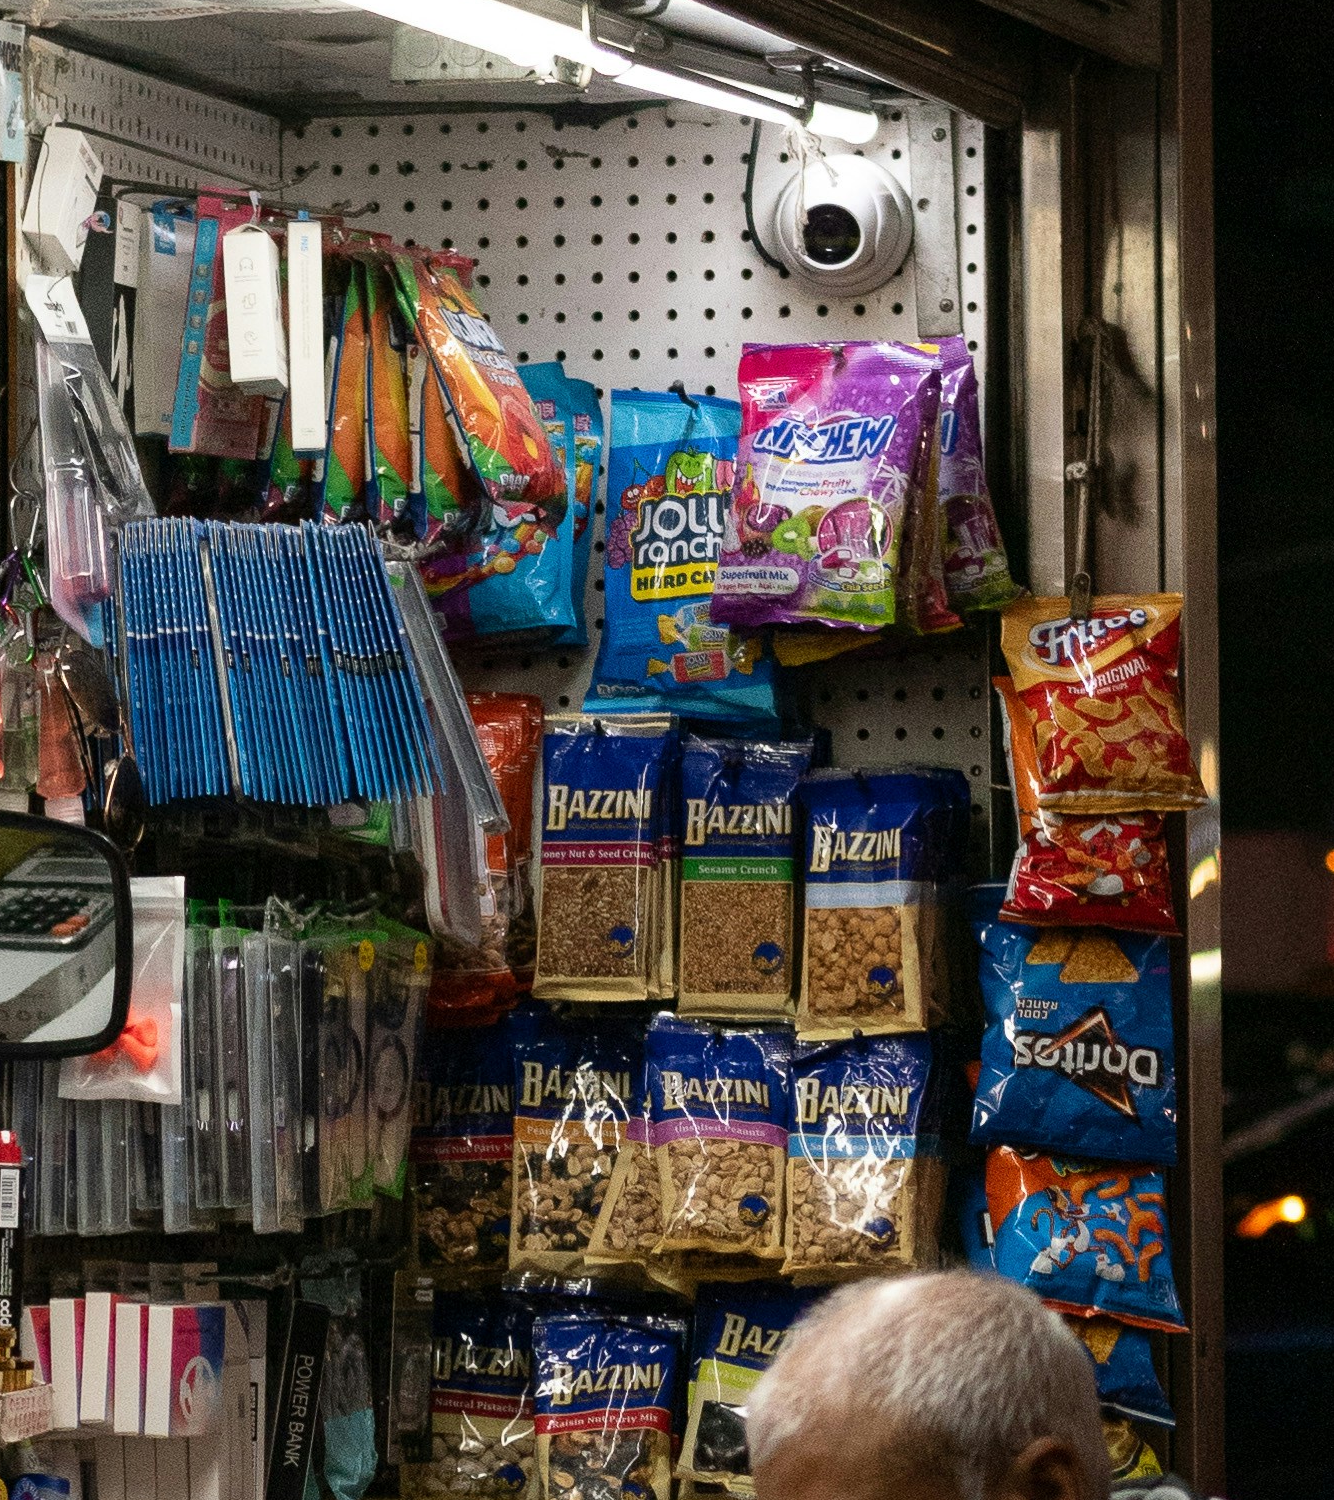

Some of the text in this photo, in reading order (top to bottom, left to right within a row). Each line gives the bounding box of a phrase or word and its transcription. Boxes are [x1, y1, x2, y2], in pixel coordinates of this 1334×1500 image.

[635, 497, 725, 542] JOLL
[637, 534, 724, 566] ranch
[636, 570, 686, 592] HARD
[720, 570, 767, 581] Superfruit
[769, 570, 790, 581] Mix
[546, 784, 653, 831] BAZZINI
[684, 798, 793, 847] BAZZINI
[541, 849, 567, 861] oney
[568, 848, 586, 859] Nut
[598, 848, 619, 859] Seed
[698, 864, 778, 875] Sesame Crunch
[809, 825, 902, 873] BAZZINI
[1014, 1035, 1159, 1087] Doritos
[413, 1081, 514, 1128] BAZZIN
[661, 1070, 770, 1111] BAZZINI
[795, 1077, 910, 1124] BAZZINI
[431, 1336, 531, 1381] BAZZIN
[435, 1398, 475, 1409] Natural
[550, 1362, 660, 1406] BAZZINI
[283, 1353, 315, 1469] POWER BANK
[553, 1418, 585, 1430] Raisin
[639, 1414, 658, 1424] Mix
